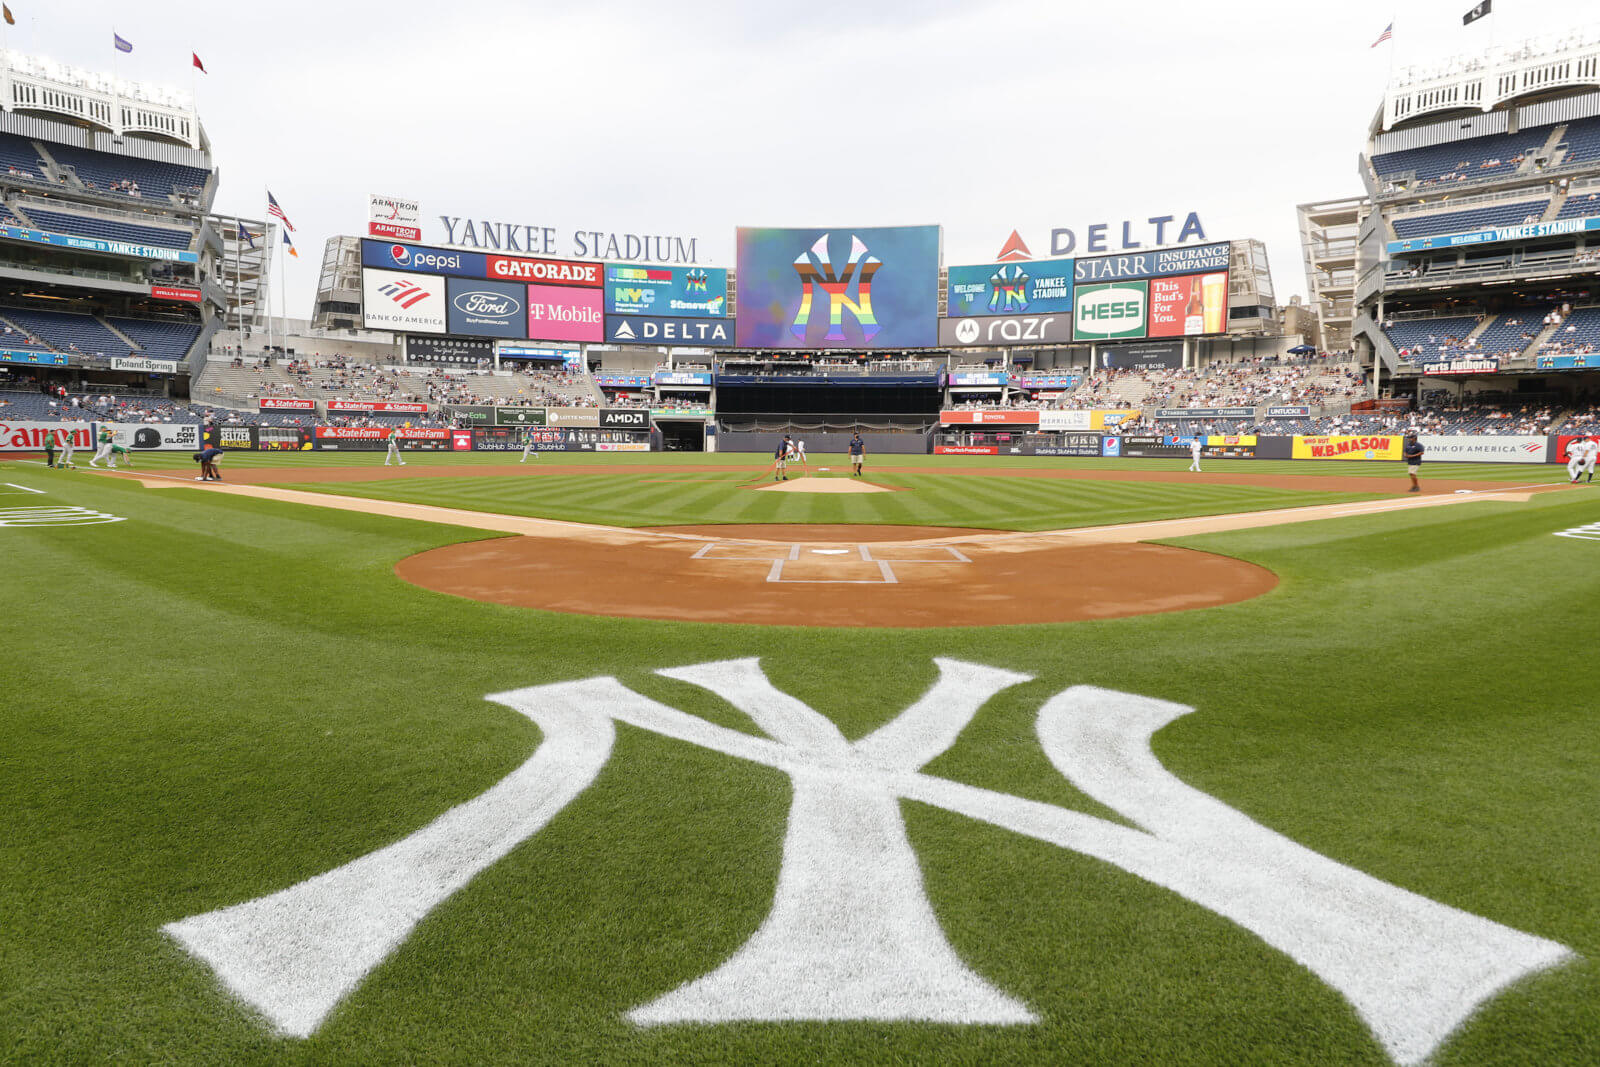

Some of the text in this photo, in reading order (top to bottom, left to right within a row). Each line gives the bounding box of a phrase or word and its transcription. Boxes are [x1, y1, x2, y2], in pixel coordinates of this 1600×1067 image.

[372, 199, 418, 211] ARMITRON
[375, 224, 416, 234] ARMITRON
[1051, 211, 1207, 256] DELTA
[1451, 233, 1482, 245] WELCOME
[1495, 225, 1535, 241] YANKEE
[1538, 218, 1586, 236] STADIUM
[440, 215, 698, 264] YANKEE STADIUM
[66, 238, 96, 249] WELCOME
[107, 242, 140, 256] YANKEE
[142, 247, 179, 260] STADIUM
[1159, 245, 1229, 262] INSURANCE
[414, 252, 460, 269] pepsi
[1158, 255, 1229, 273] COMPANIES
[494, 260, 596, 281] GATORADE
[1075, 256, 1149, 280] STARR
[953, 284, 985, 293] WELCOME
[1034, 277, 1066, 288] YANKEE
[1154, 281, 1179, 292] This
[615, 288, 655, 303] NYC
[965, 293, 974, 302] TO
[1032, 287, 1067, 299] STADIUM
[1154, 292, 1183, 302] Bud's
[466, 294, 508, 314] Ford
[1081, 301, 1139, 320] HESS
[1154, 303, 1172, 313] For
[547, 305, 601, 323] Mobile
[1154, 313, 1177, 323] You.
[404, 317, 443, 326] AMERICA
[643, 322, 727, 340] DELTA
[988, 318, 1054, 341] razr
[115, 359, 173, 373] Poland Spring
[1423, 362, 1449, 372] Parts
[1450, 360, 1497, 370] Authority
[469, 411, 487, 419] Eats
[605, 413, 633, 424] AMD
[220, 431, 250, 441] SELTZER
